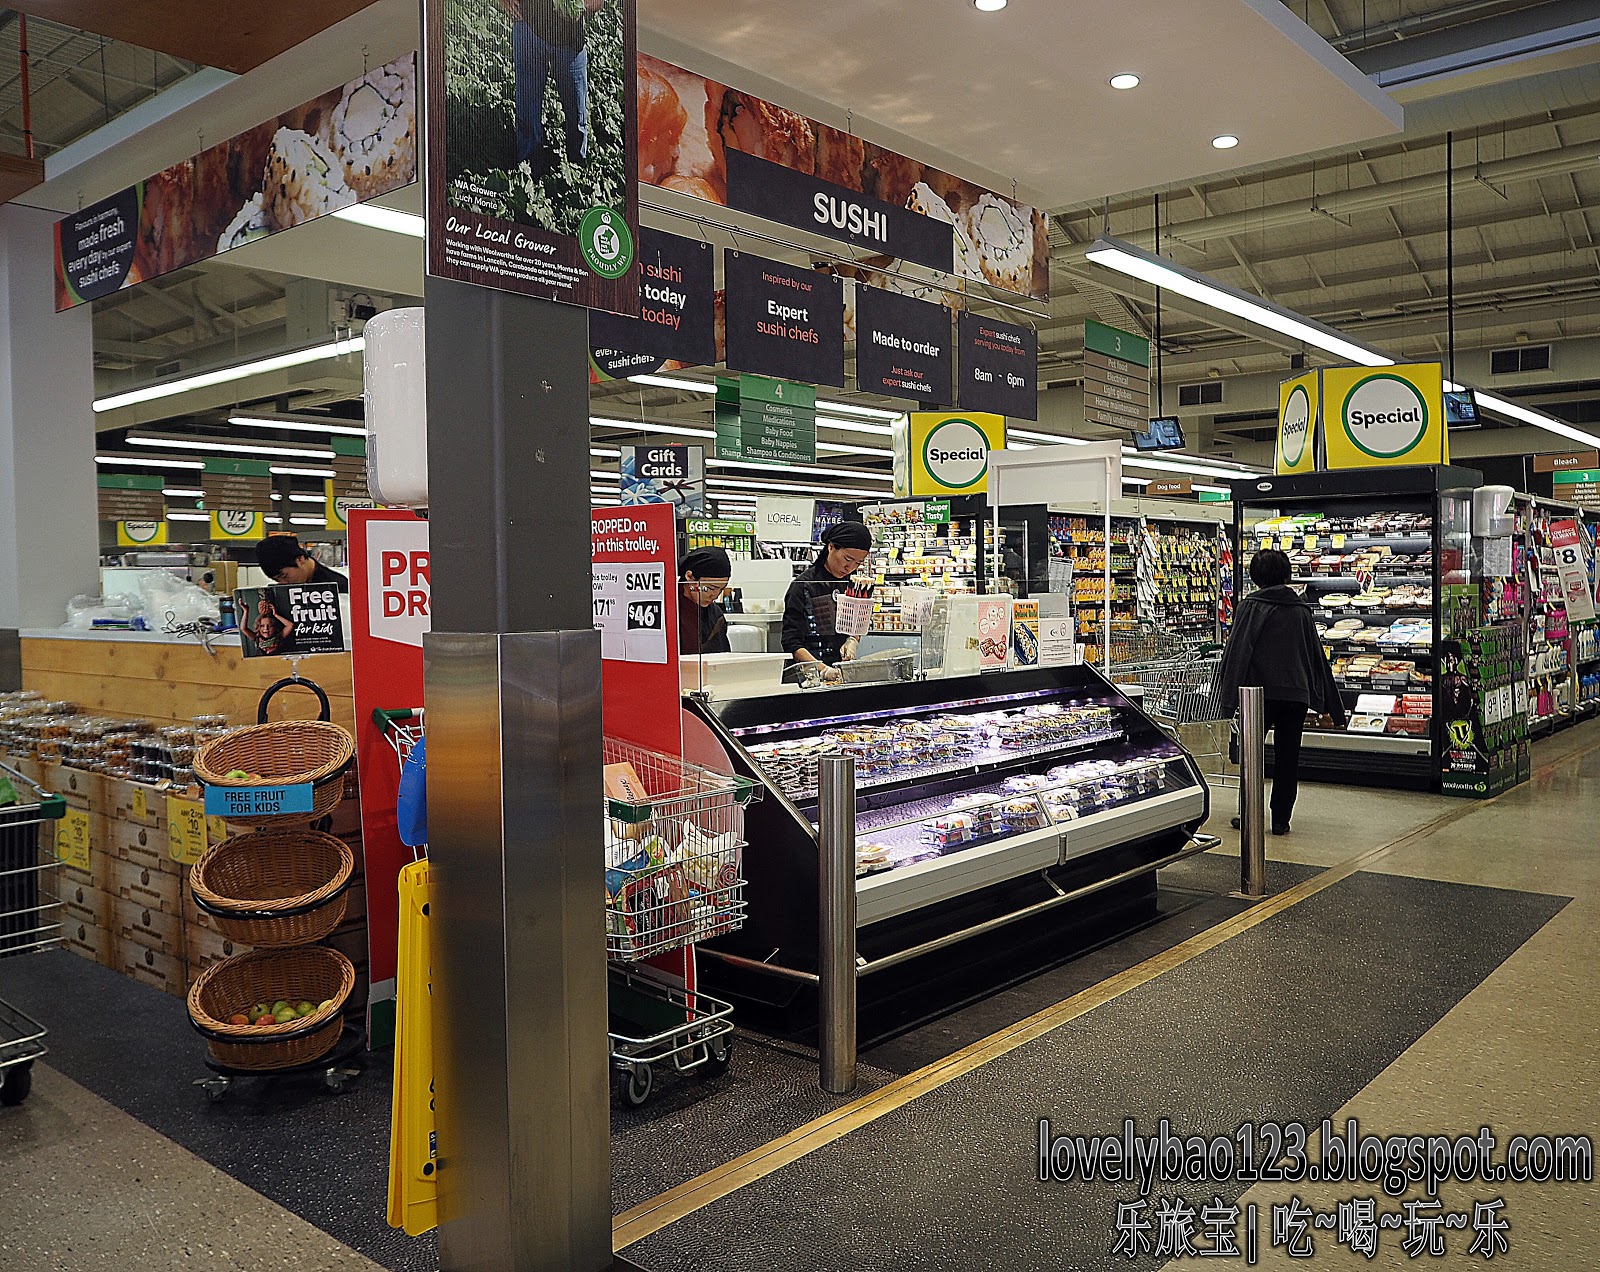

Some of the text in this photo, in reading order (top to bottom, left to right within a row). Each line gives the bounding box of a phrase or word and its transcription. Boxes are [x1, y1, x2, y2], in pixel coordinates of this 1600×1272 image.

[454, 179, 497, 198] WA Grower
[455, 191, 498, 210] Luch Monte
[814, 192, 887, 242] SUSHI
[78, 231, 99, 251] made
[99, 216, 124, 241] fresh
[446, 217, 557, 255] Our Local Grower
[445, 238, 470, 251] Working
[470, 245, 482, 253] with
[482, 247, 515, 260] Woolworths
[446, 247, 460, 256] have
[461, 250, 477, 260] farms
[68, 255, 88, 273] every
[88, 250, 101, 264] day
[446, 256, 459, 266] they
[471, 262, 489, 272] supply
[587, 248, 627, 271] PROUDLY WA
[79, 260, 120, 288] sushi chefs
[647, 263, 682, 283] sushi
[762, 271, 813, 291] Inspired by our
[644, 283, 686, 309] today
[642, 306, 681, 331] today
[768, 299, 808, 322] Expert
[757, 321, 819, 344] sushi chefs
[872, 330, 940, 357] Made to order
[1116, 336, 1121, 352] 3
[608, 355, 630, 369] sushi
[1107, 359, 1128, 371] Pet food
[891, 366, 903, 375] Just
[904, 369, 914, 377] ask
[974, 367, 1025, 388] 8am 6pm
[1107, 372, 1128, 385] Electrical
[775, 384, 783, 399] 4
[882, 377, 931, 392] expert sushi chefs
[1103, 385, 1132, 399] Light globes
[765, 404, 793, 415] Cosmetics
[1095, 397, 1140, 415] Home maintenance
[762, 415, 796, 427] Medications
[1097, 411, 1138, 427] Family underwear
[1351, 407, 1420, 429] Special
[765, 426, 793, 438] Baby Food
[1284, 416, 1306, 440] Special
[761, 437, 797, 449] Baby Nappies
[648, 449, 676, 462] Gift
[746, 446, 772, 458] Shampoo
[778, 451, 811, 462] Conditioners
[930, 448, 984, 464] Special
[1554, 457, 1578, 466] Bleach
[641, 463, 682, 476] Cards
[1583, 473, 1589, 481] 3
[338, 501, 372, 511] Special
[926, 504, 948, 512] Souper
[592, 518, 647, 535] ROPPED on
[815, 516, 844, 524] MAYBE
[596, 538, 605, 552] in
[606, 537, 624, 552] this
[625, 536, 660, 555] trolley.
[382, 551, 430, 586] PR
[601, 573, 618, 583] trolley
[626, 573, 661, 590] SAVE
[593, 583, 604, 591] OW
[289, 588, 334, 604] Free
[383, 590, 431, 617] DR
[291, 604, 337, 622] fruit
[295, 623, 333, 636] for kids
[1442, 782, 1473, 790] Woolworths
[224, 790, 285, 802] FREE FRUIT
[190, 808, 195, 818] 2
[230, 802, 280, 813] FOR KIDS
